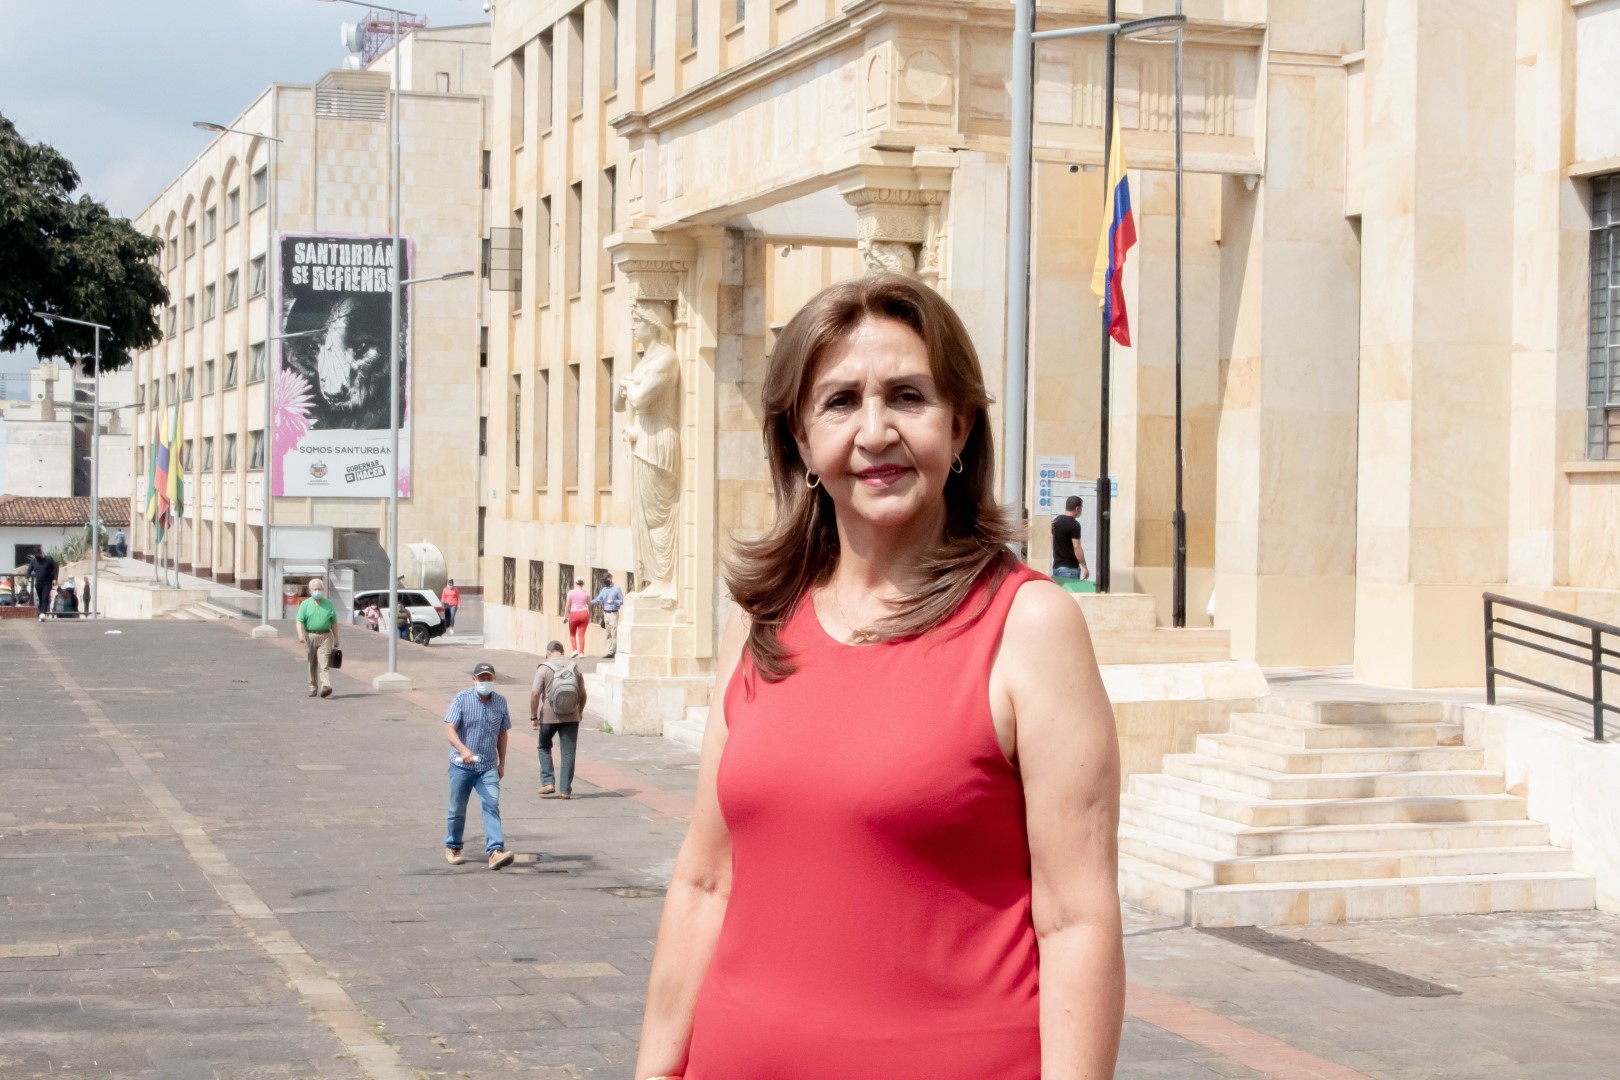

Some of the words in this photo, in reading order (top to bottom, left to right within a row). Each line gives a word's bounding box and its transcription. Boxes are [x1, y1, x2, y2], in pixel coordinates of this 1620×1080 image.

[294, 241, 394, 266] SANTURBÁN
[292, 265, 309, 284] SE
[300, 446, 333, 454] SOMOS
[346, 459, 379, 472] GOBERNAR
[356, 466, 385, 481] HACER
